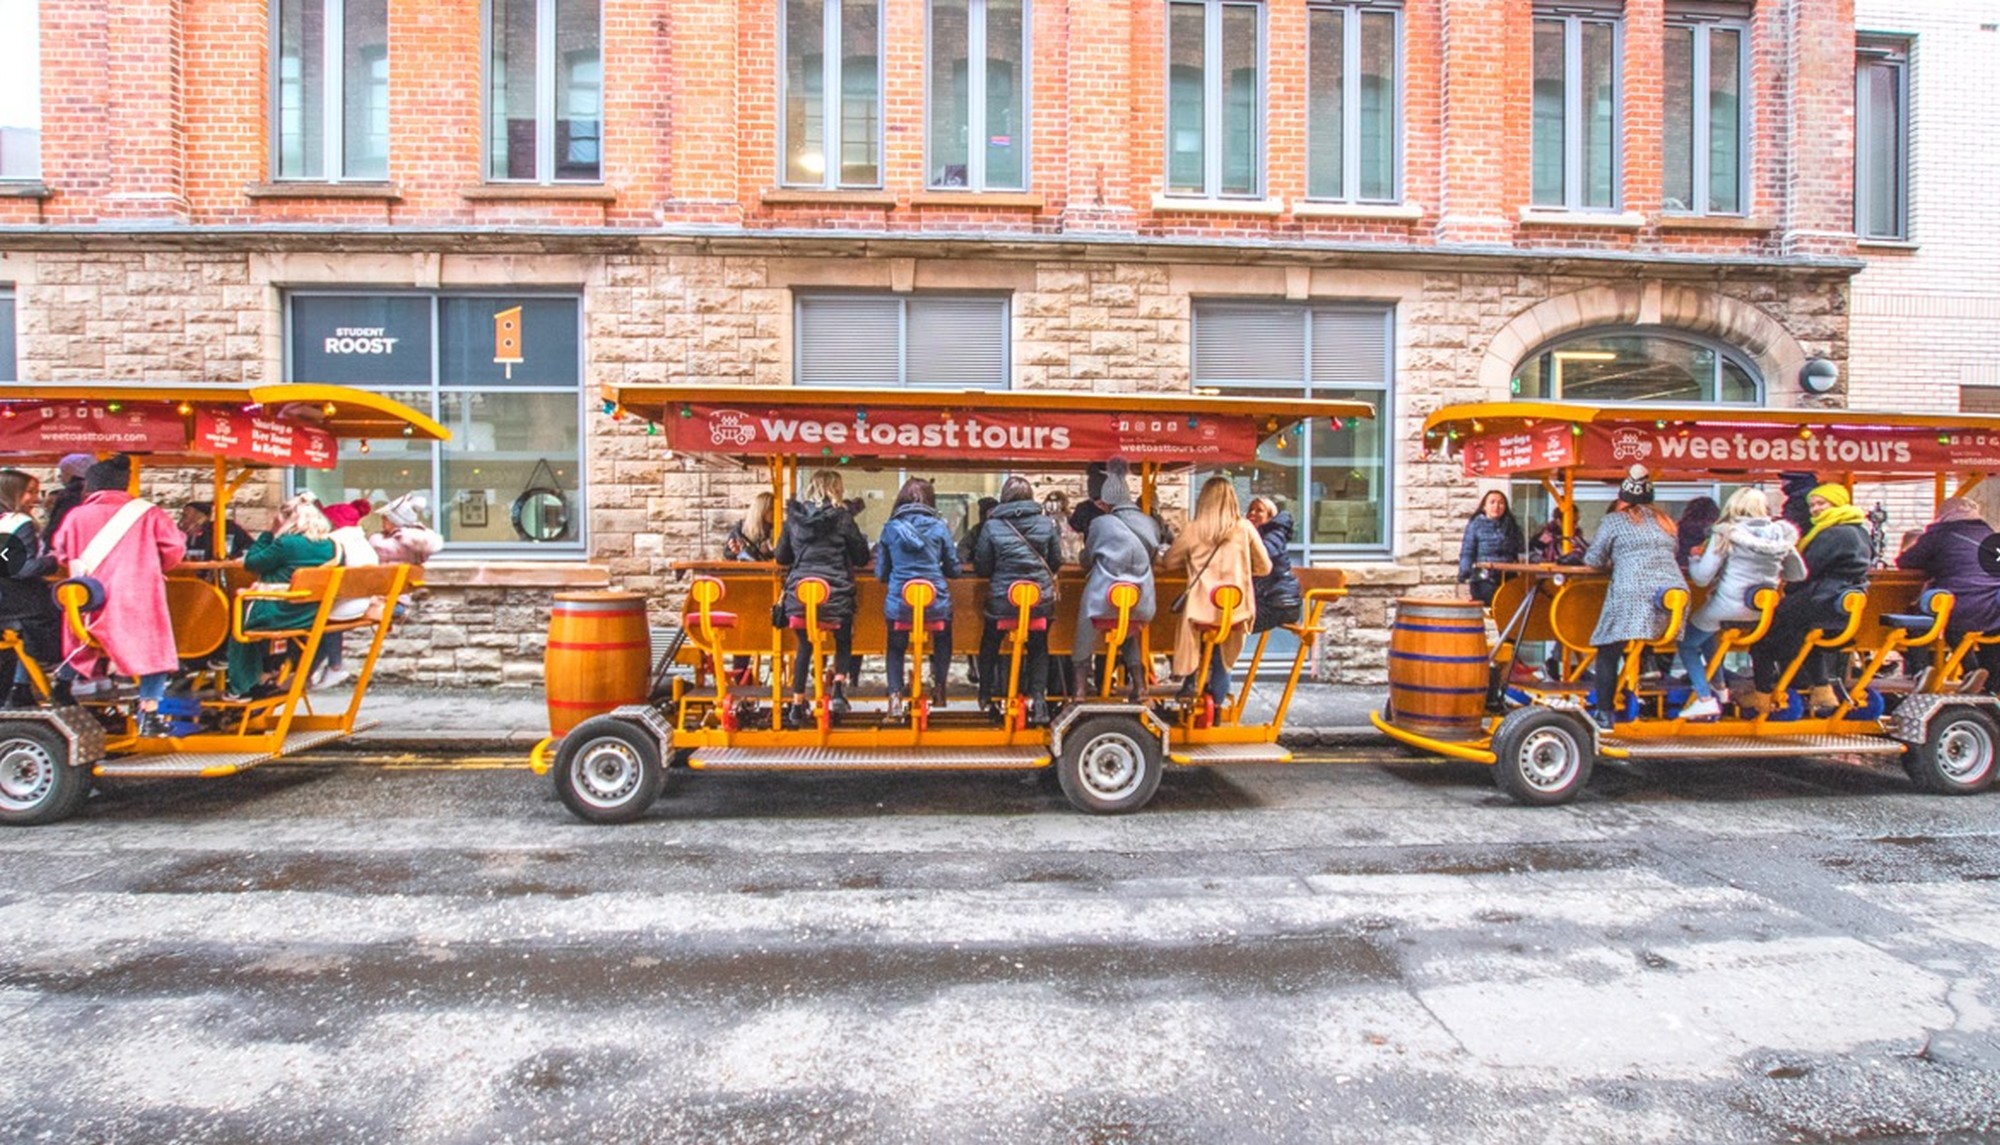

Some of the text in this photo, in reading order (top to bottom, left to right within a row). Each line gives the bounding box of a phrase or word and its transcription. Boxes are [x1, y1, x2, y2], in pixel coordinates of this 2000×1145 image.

[336, 327, 385, 337] STUDENT
[325, 337, 399, 354] ROOST
[41, 432, 147, 441] weetoasttours.com
[760, 418, 1071, 449] wee toast tours
[1121, 443, 1219, 453] weetoasttours.com
[1656, 433, 1911, 462] wee toast tours
